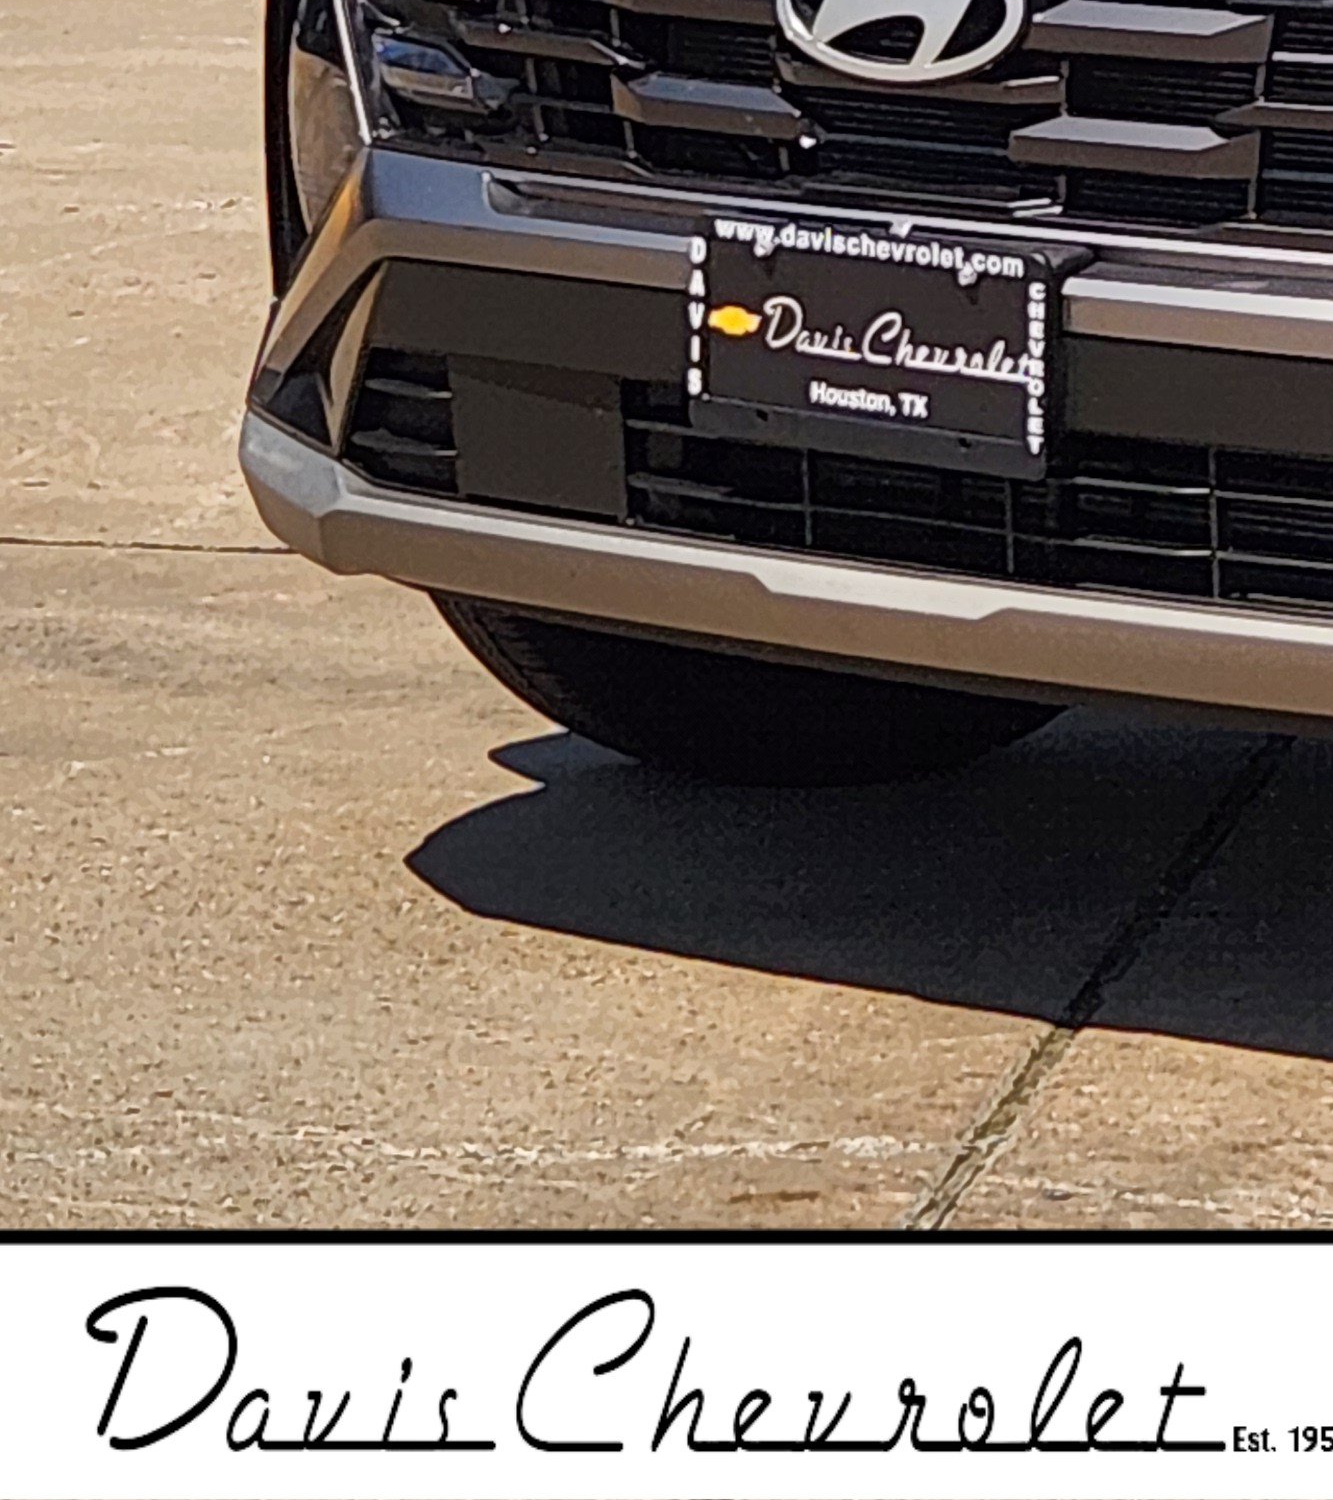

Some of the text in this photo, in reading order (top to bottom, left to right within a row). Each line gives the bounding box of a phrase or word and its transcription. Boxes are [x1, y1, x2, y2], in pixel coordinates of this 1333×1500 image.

[713, 218, 1025, 278] www.davischevrolet.com
[687, 235, 708, 397] DAVIS
[762, 295, 1034, 383] Davis Chevrolet
[809, 380, 929, 419] Houston, TX
[1026, 281, 1047, 456] CHEVROLET
